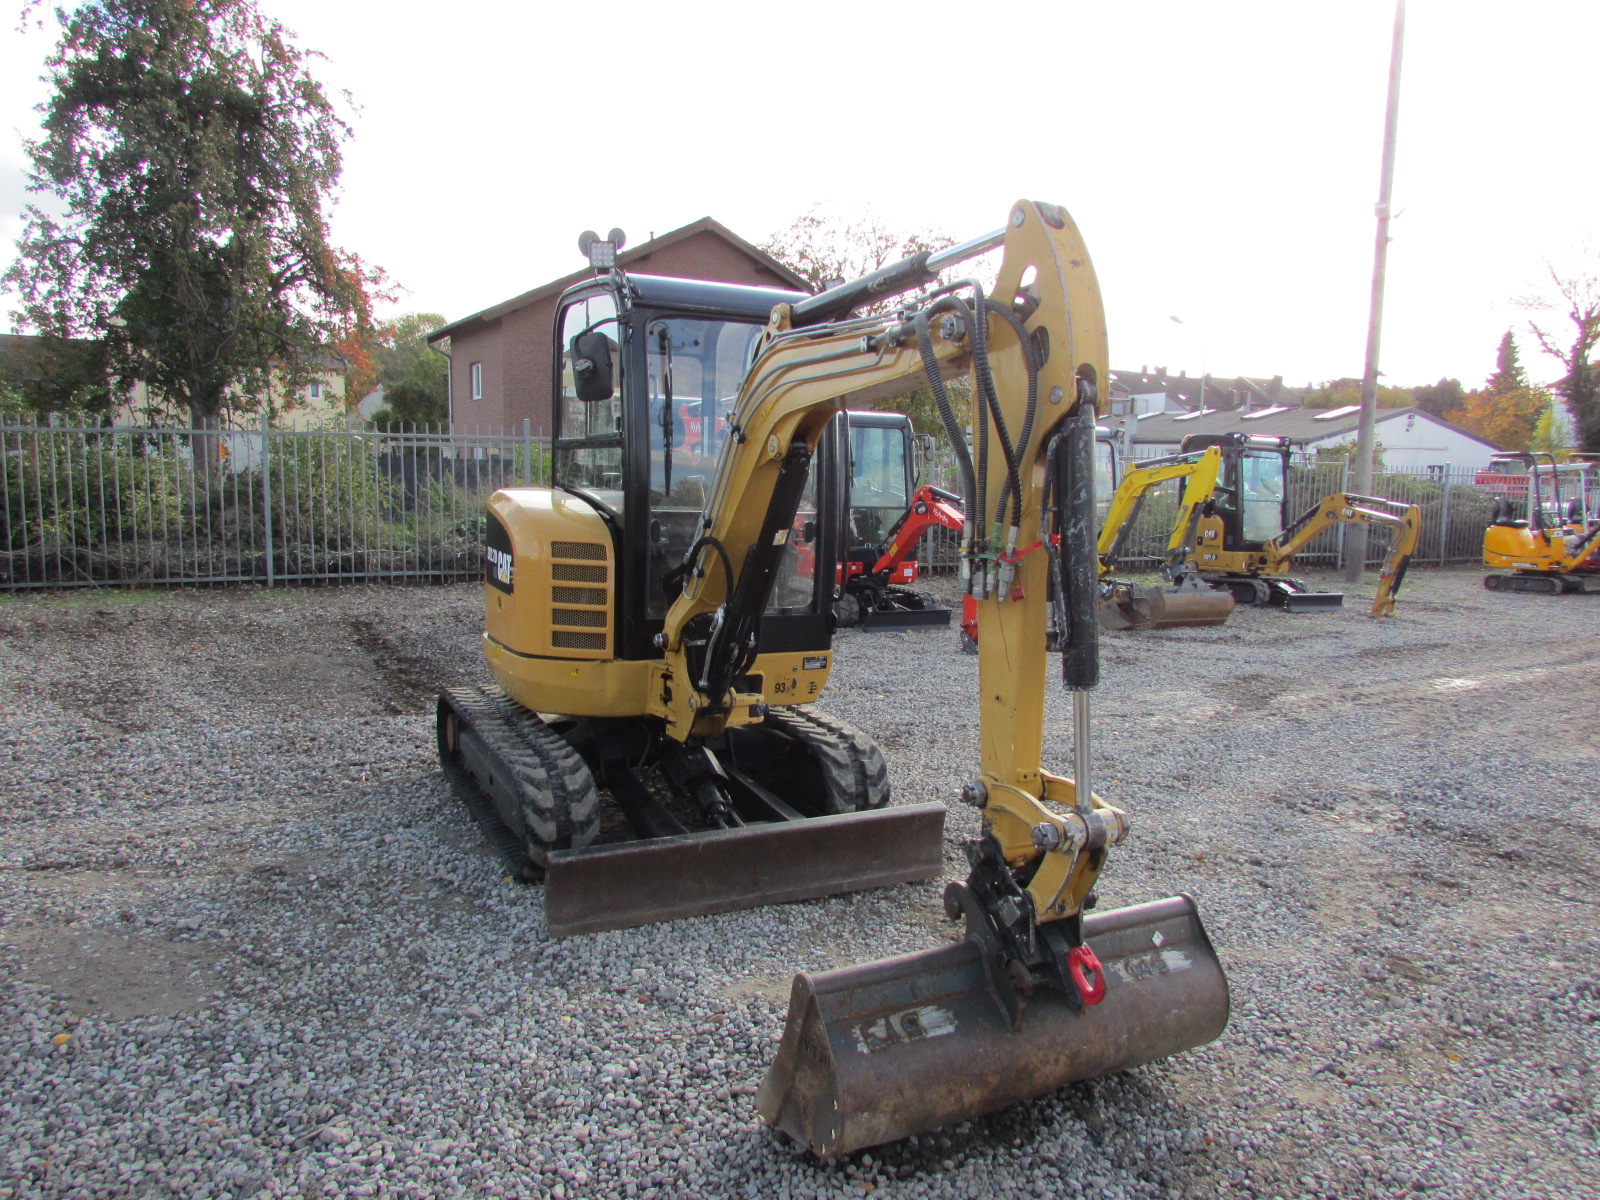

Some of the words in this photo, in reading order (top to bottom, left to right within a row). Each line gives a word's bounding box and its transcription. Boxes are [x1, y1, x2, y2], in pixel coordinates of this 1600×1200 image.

[933, 507, 949, 524] Kubota
[498, 551, 512, 584] CAT
[774, 682, 786, 693] 93
